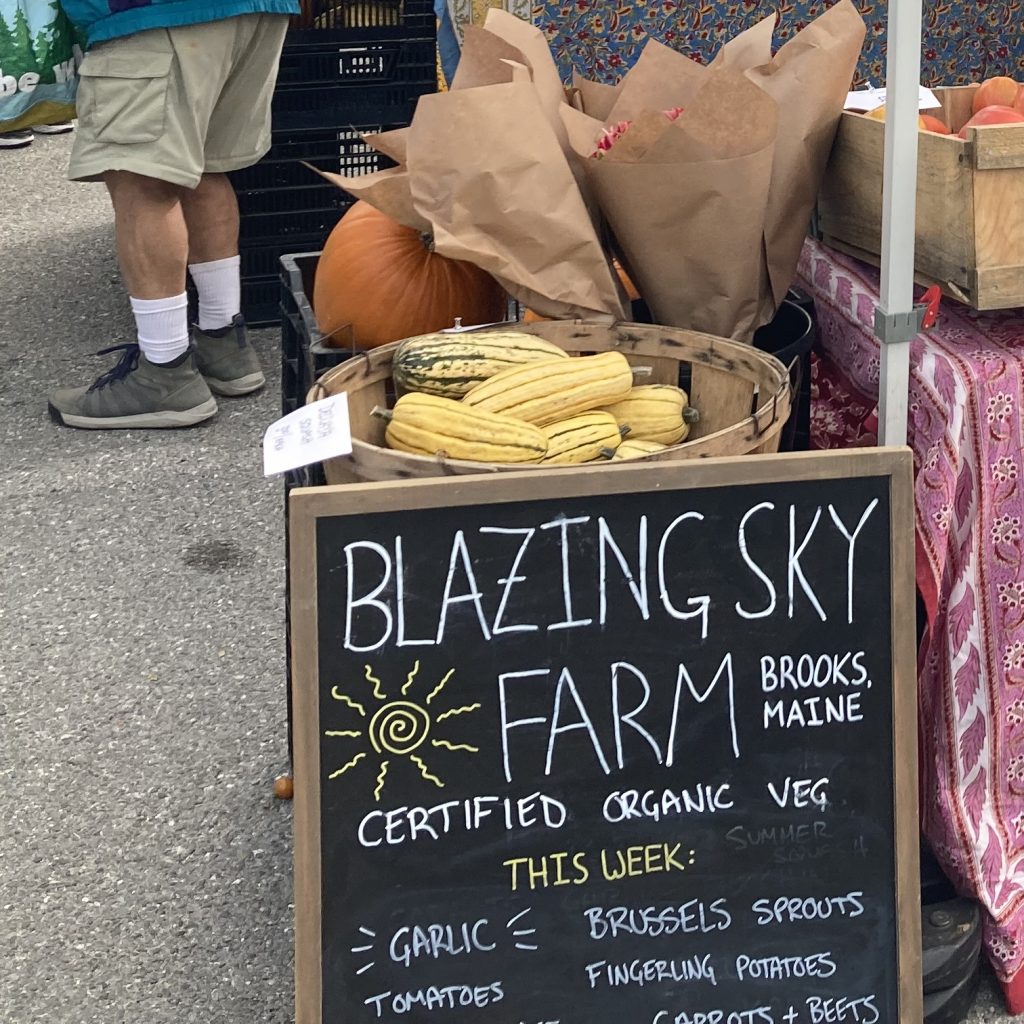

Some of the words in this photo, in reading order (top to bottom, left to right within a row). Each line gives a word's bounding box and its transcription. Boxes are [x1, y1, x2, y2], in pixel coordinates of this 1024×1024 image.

[343, 511, 711, 652] BLAZING
[735, 498, 879, 624] SKY
[760, 651, 872, 692] BROOKS,
[498, 652, 740, 782] FARM
[763, 692, 864, 729] MAINE
[357, 792, 567, 848] CERTIFIED
[602, 783, 734, 823] ORGANIC
[767, 777, 829, 812] VEG
[726, 821, 832, 850] SUMMER
[503, 851, 589, 891] THIS
[601, 842, 696, 881] WEEK:
[583, 898, 732, 940] BRUSSELS
[751, 891, 865, 925] SPROUTS
[389, 918, 497, 967] GARLIC
[584, 953, 717, 988] FINGERLING
[736, 951, 837, 981] POTATOES
[364, 981, 504, 1017] TOMATOES
[805, 994, 880, 1024] BEETS
